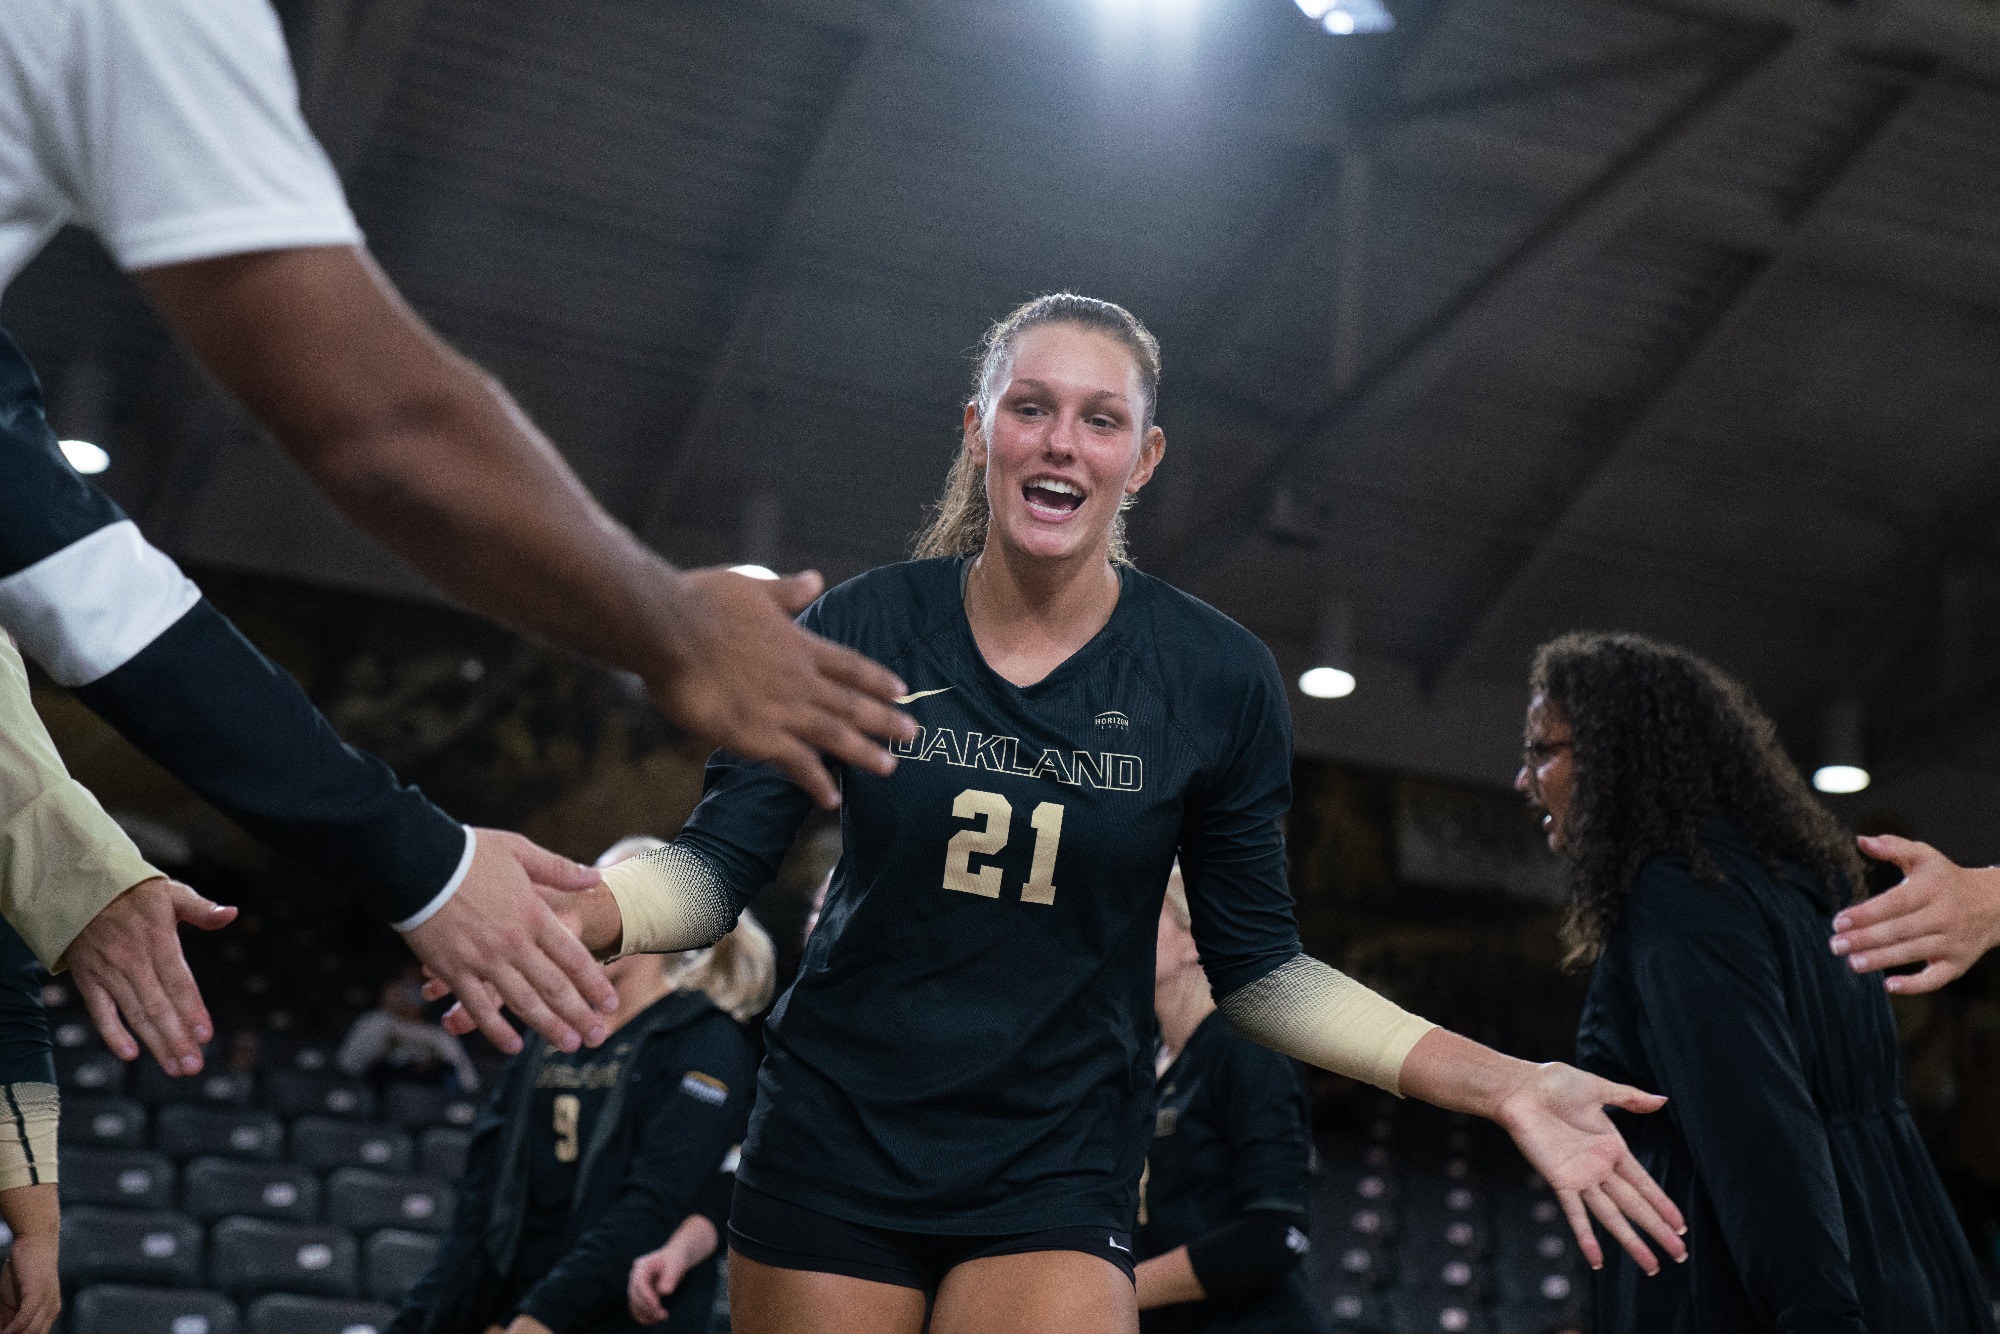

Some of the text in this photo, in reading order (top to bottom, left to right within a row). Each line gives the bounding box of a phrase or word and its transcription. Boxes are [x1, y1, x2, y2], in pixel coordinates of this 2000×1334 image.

[1094, 717, 1129, 727] HORIZON
[889, 726, 1143, 792] OAKLAND
[942, 788, 1065, 906] 21
[553, 1093, 580, 1163] 9
